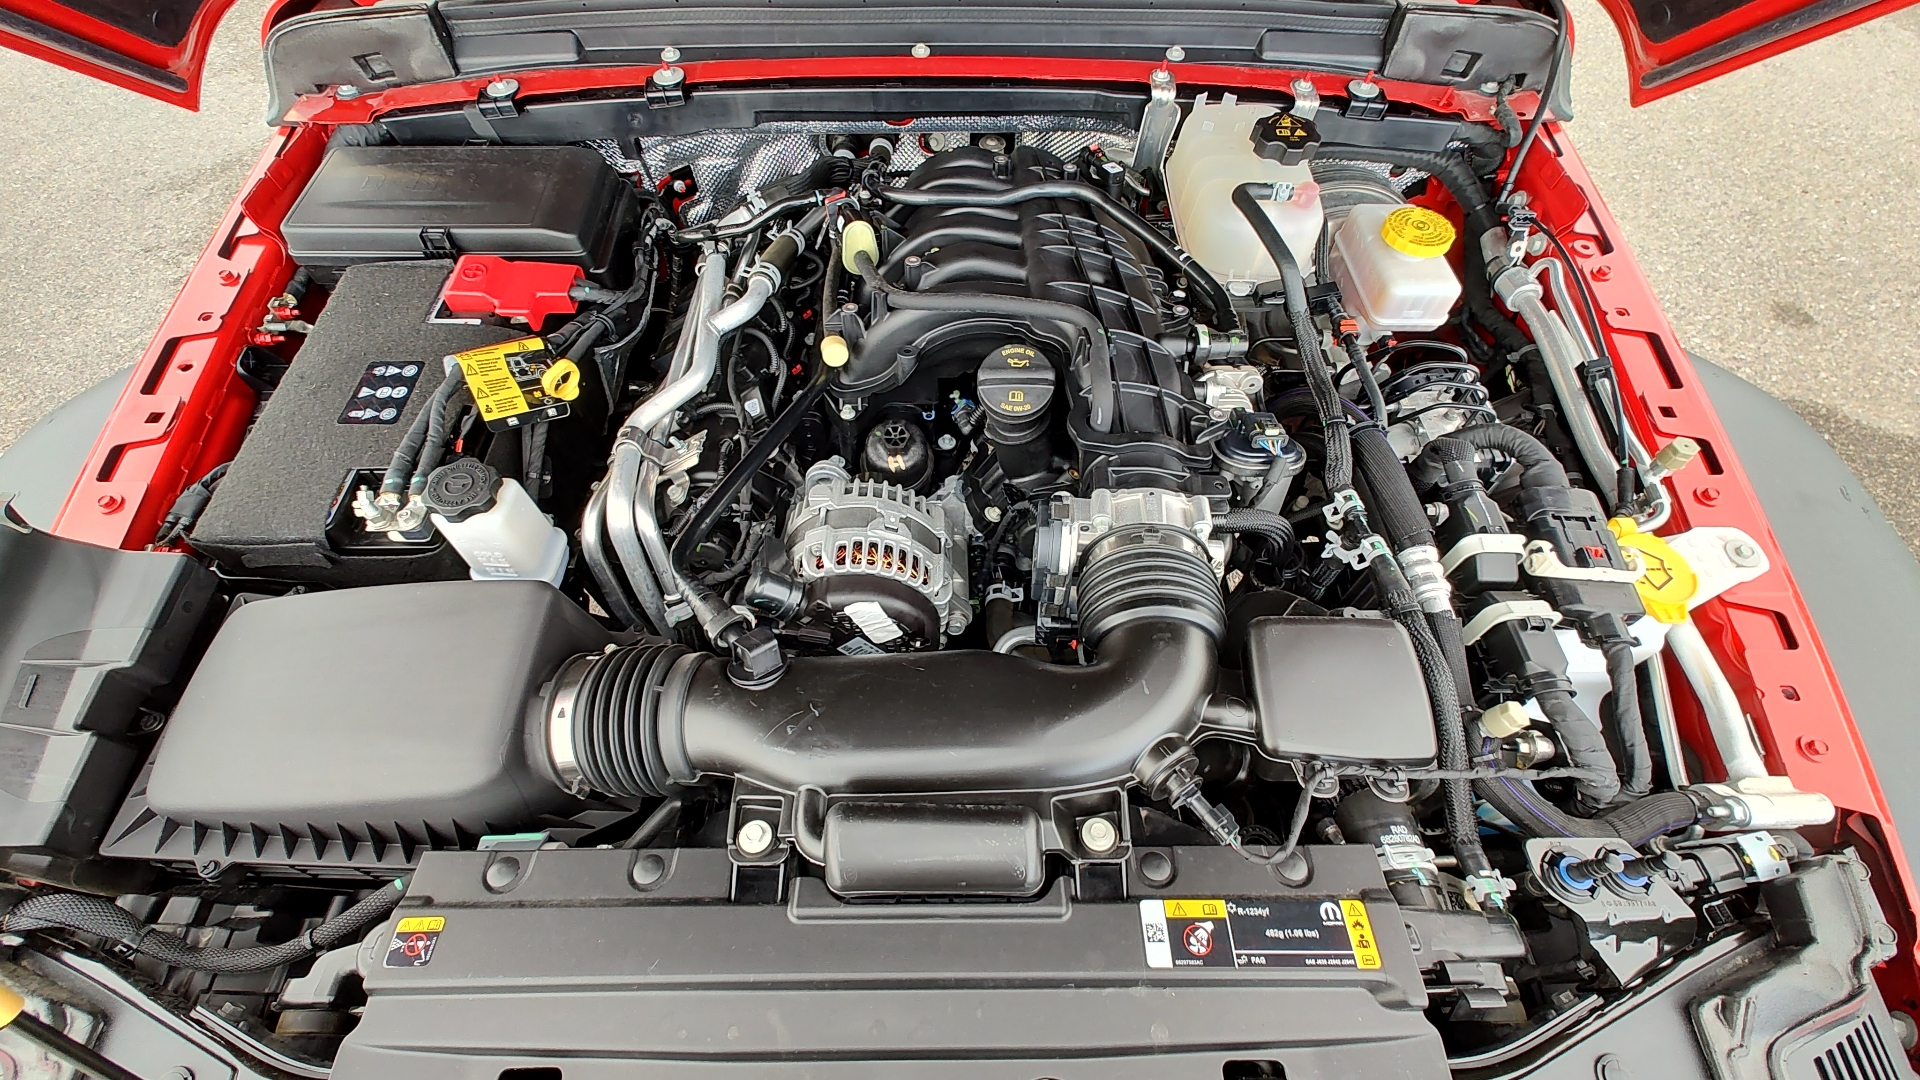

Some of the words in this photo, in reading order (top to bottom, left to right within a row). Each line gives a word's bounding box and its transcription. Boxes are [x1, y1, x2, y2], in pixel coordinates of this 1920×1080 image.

[1001, 347, 1025, 357] ENGINE
[1025, 349, 1035, 358] OIL
[1000, 402, 1013, 412] SAE
[1013, 404, 1031, 412] 0W-20
[1389, 825, 1408, 834] RAD
